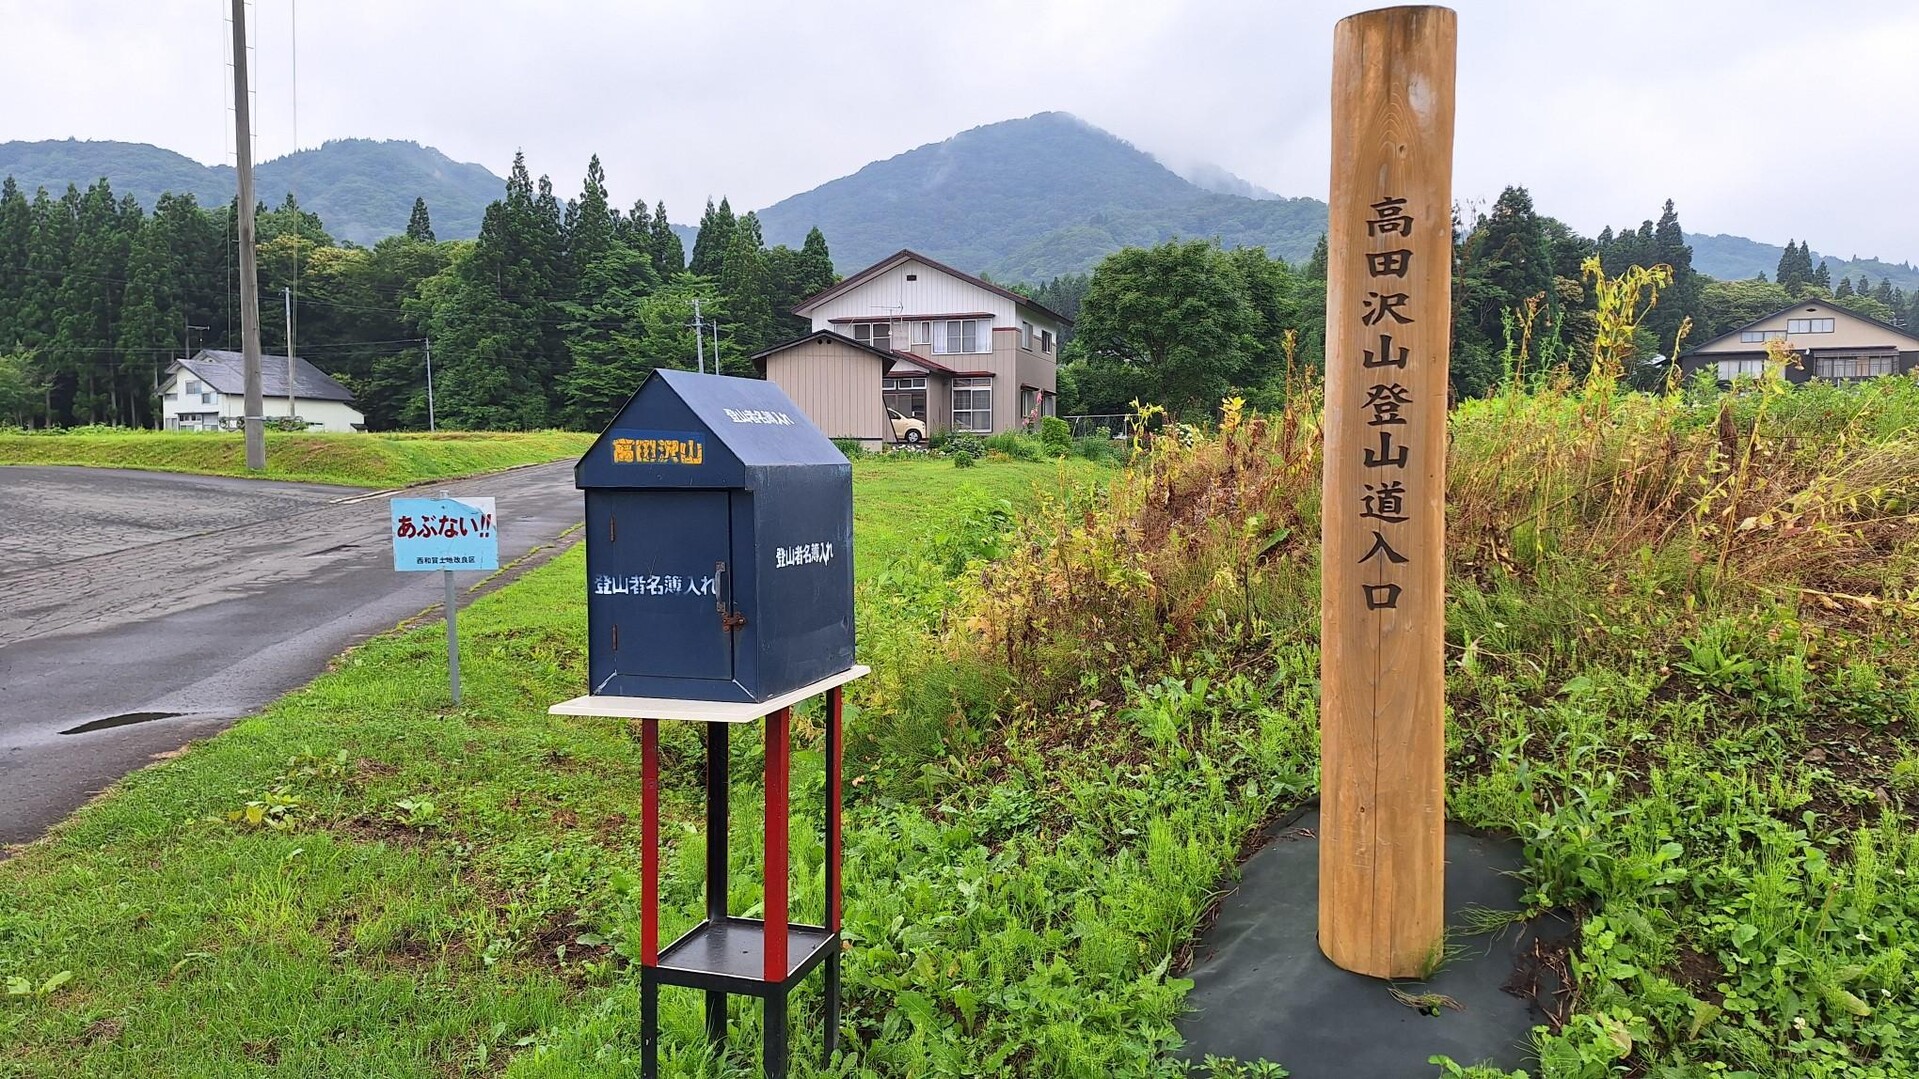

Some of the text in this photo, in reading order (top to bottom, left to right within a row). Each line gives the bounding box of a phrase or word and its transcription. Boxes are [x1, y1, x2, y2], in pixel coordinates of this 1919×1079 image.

[1358, 196, 1415, 611] 高田沢山登山道入口
[612, 438, 703, 464] 高田沢山
[776, 541, 833, 568] 登山者名簿入れ
[594, 574, 717, 596] 登山者名簿入れ
